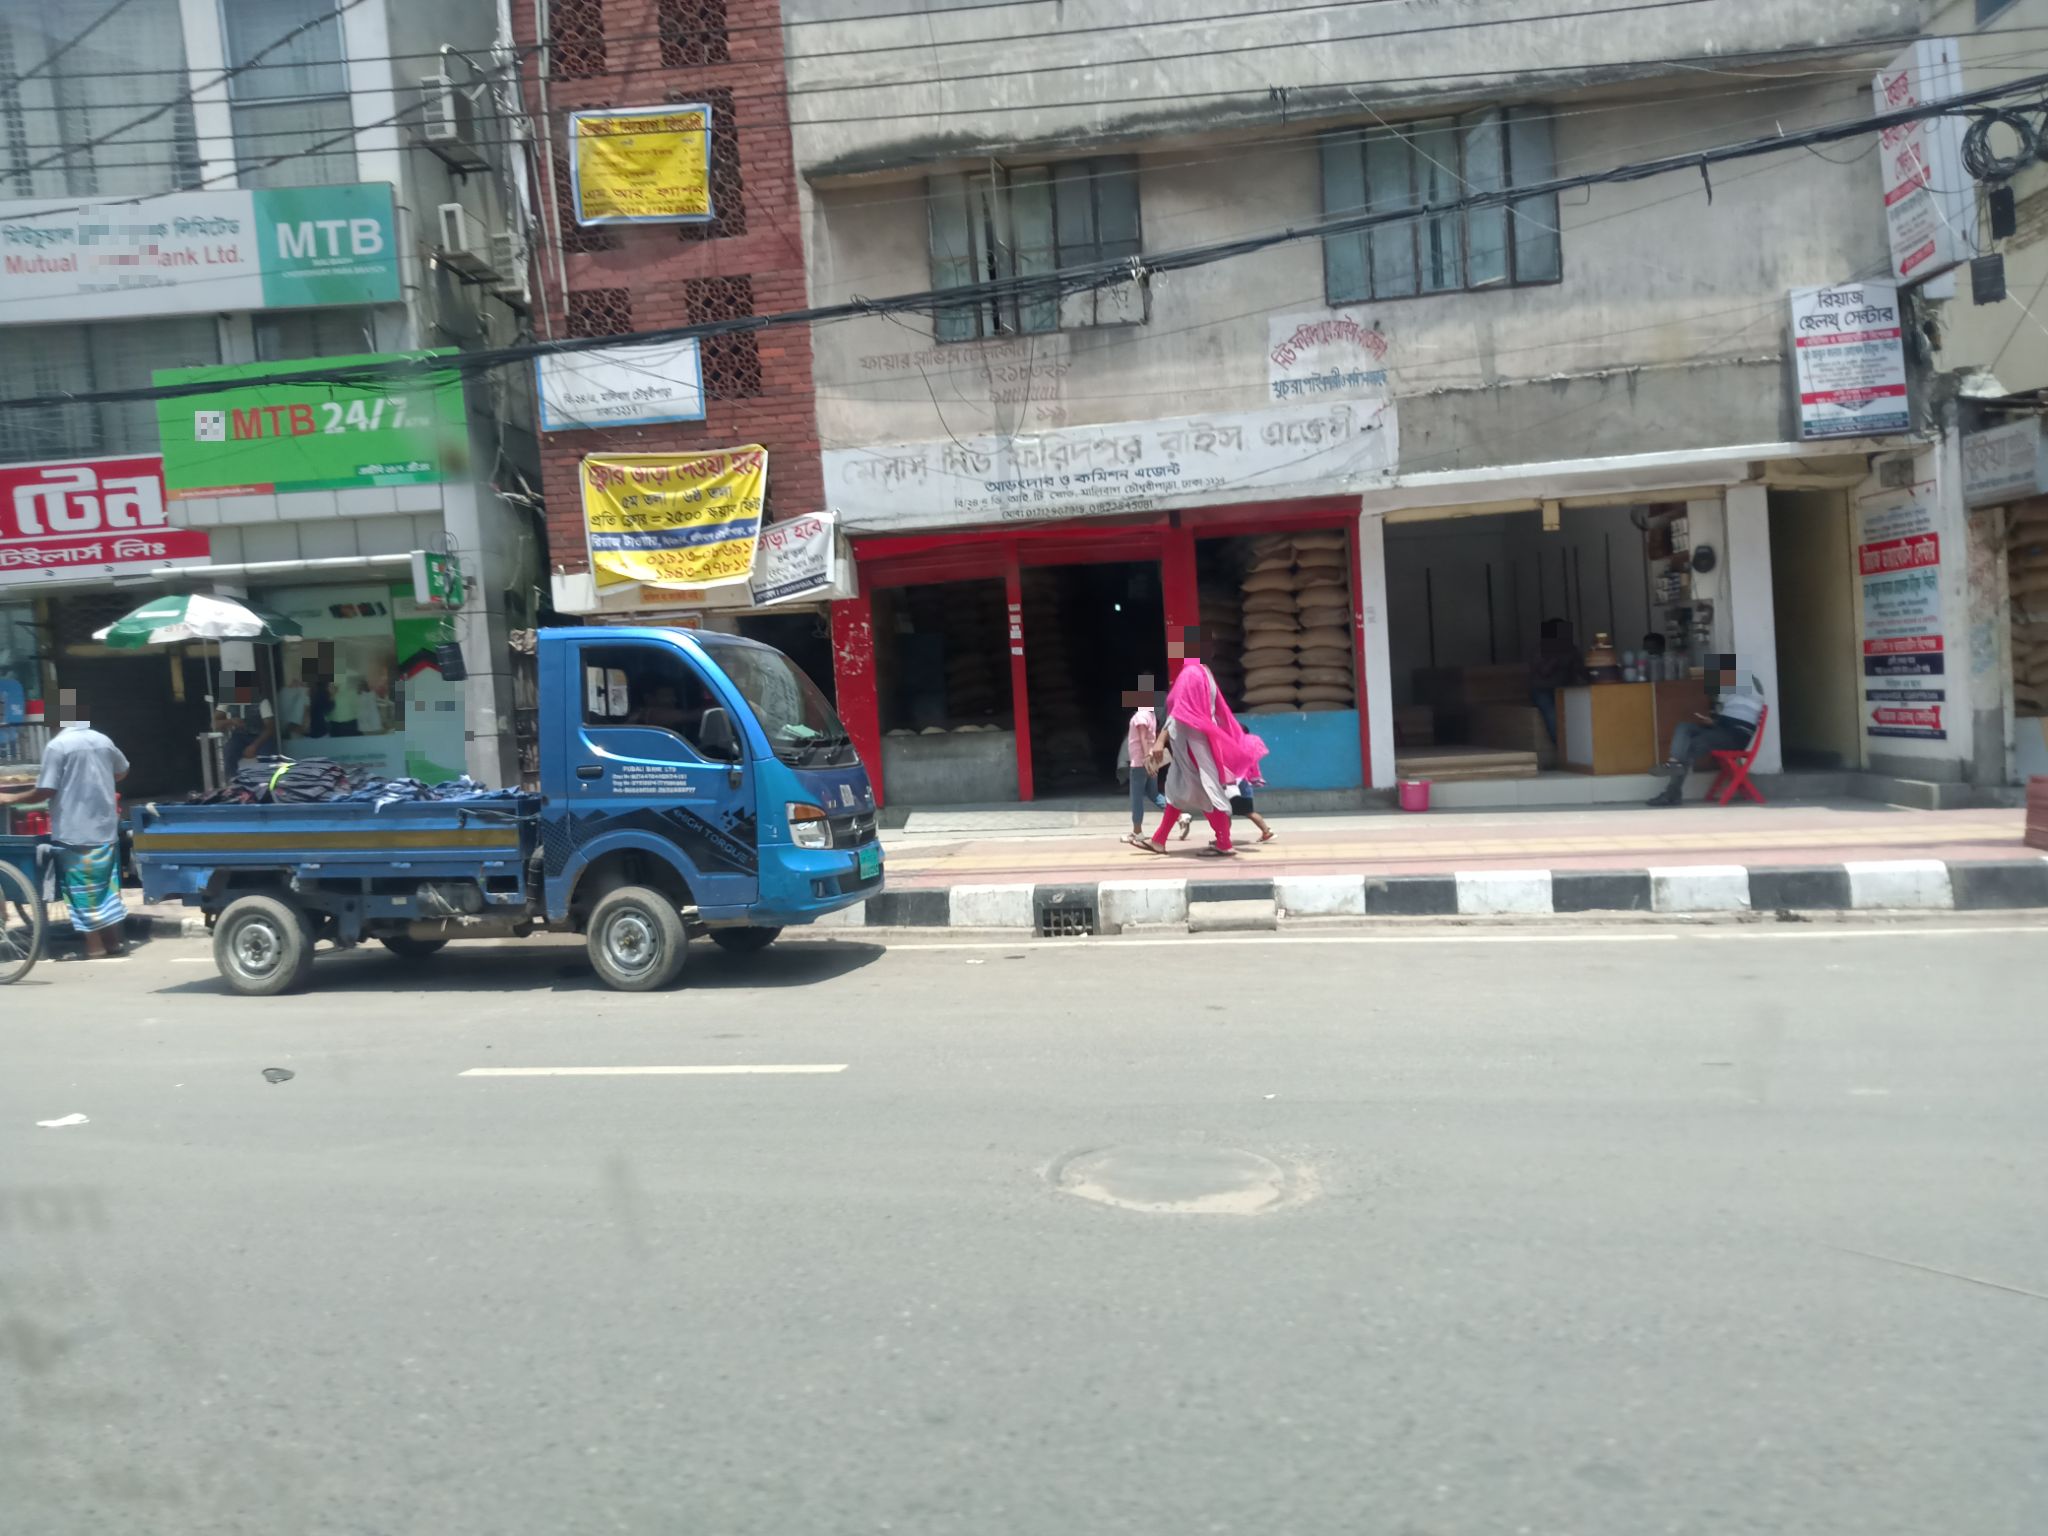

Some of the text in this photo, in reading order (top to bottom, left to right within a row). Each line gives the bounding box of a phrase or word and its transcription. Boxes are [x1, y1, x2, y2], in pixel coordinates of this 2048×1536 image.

[276, 218, 384, 259] MTB
[4, 244, 244, 274] Mutual ank Ltd.
[1817, 288, 1864, 308] রিয়াজ
[1844, 306, 1893, 326] সেন্টার
[859, 353, 911, 371] ফায়ার
[232, 403, 316, 440] MTB
[321, 397, 407, 434] 24/7
[1006, 432, 1142, 470] ফরিদপুর
[1157, 420, 1243, 459] রাইস
[632, 464, 671, 487] ভাড়া
[675, 454, 726, 482] দেওয়া
[730, 451, 763, 475] হবে
[1074, 467, 1129, 483] কমিশন
[1134, 462, 1181, 479] এজেন্ট
[13, 467, 168, 534] টেন
[643, 491, 667, 506] তলা
[707, 485, 733, 500] তলা
[590, 510, 617, 527] প্রতি
[666, 510, 703, 525] ২৫০০
[794, 519, 824, 541] হবে
[112, 538, 167, 560] লিঃ
[704, 830, 747, 863] TORQUE
